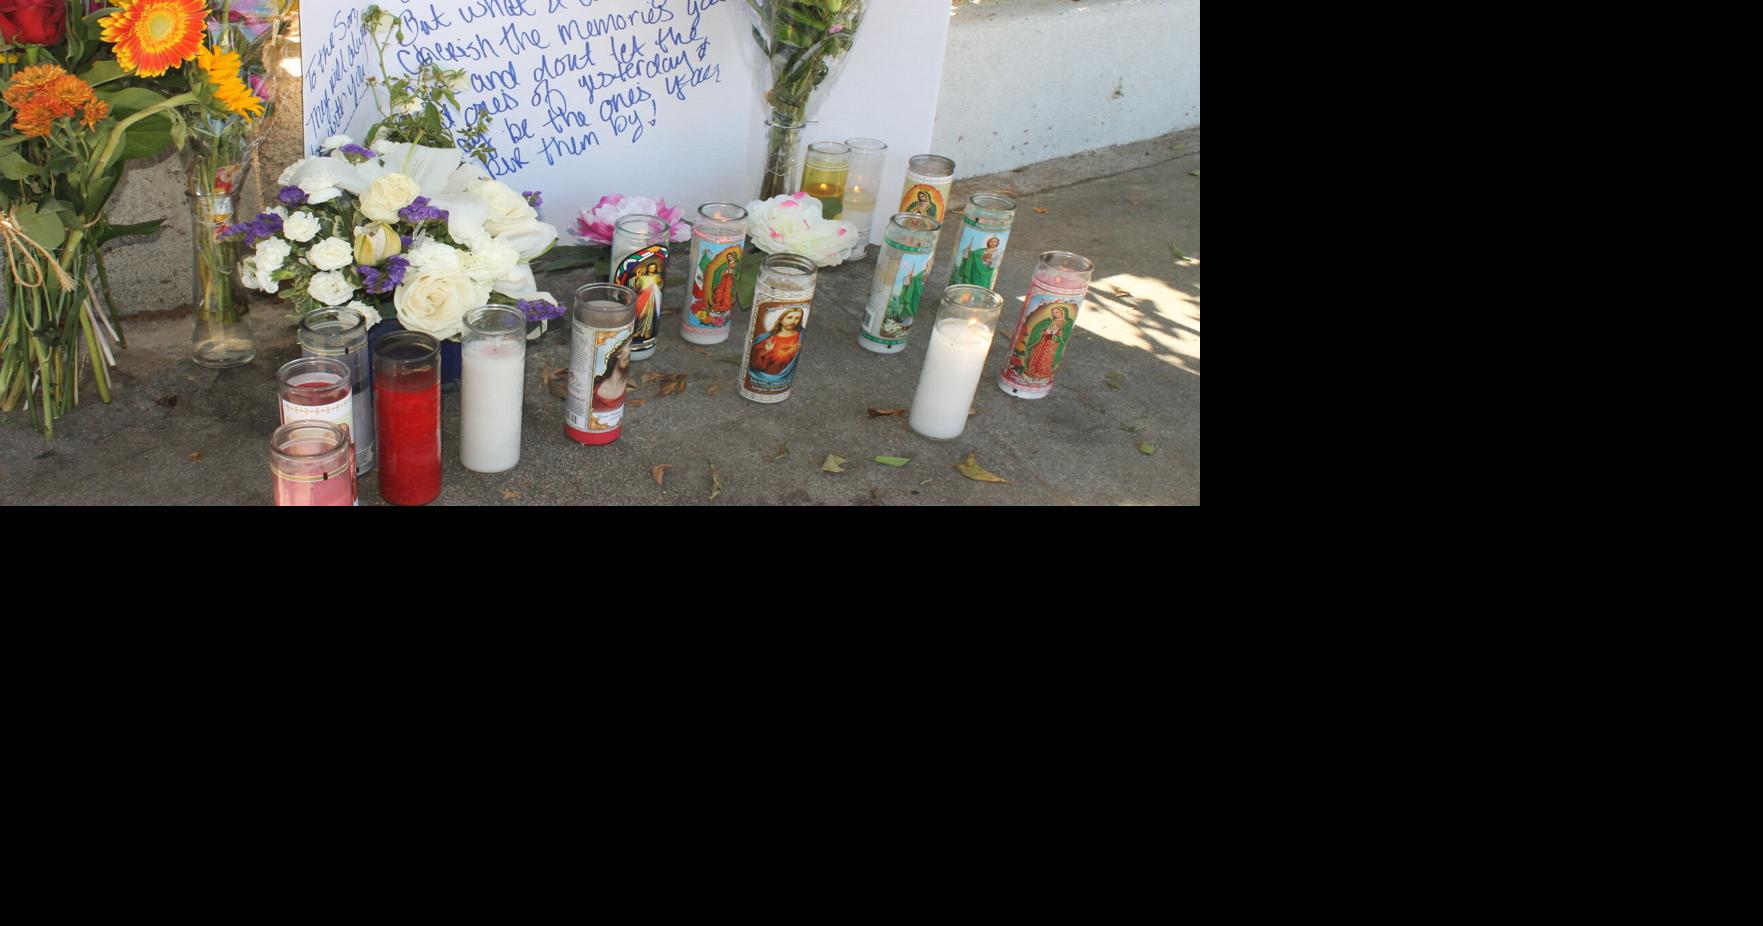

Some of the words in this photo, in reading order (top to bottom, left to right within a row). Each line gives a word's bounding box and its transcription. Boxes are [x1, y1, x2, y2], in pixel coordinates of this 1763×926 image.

[399, 4, 451, 46] But
[500, 22, 551, 55] the
[471, 61, 520, 93] and
[610, 35, 645, 64] let
[655, 27, 704, 53] the
[504, 118, 535, 144] be
[543, 106, 592, 134] the
[536, 131, 600, 166] them
